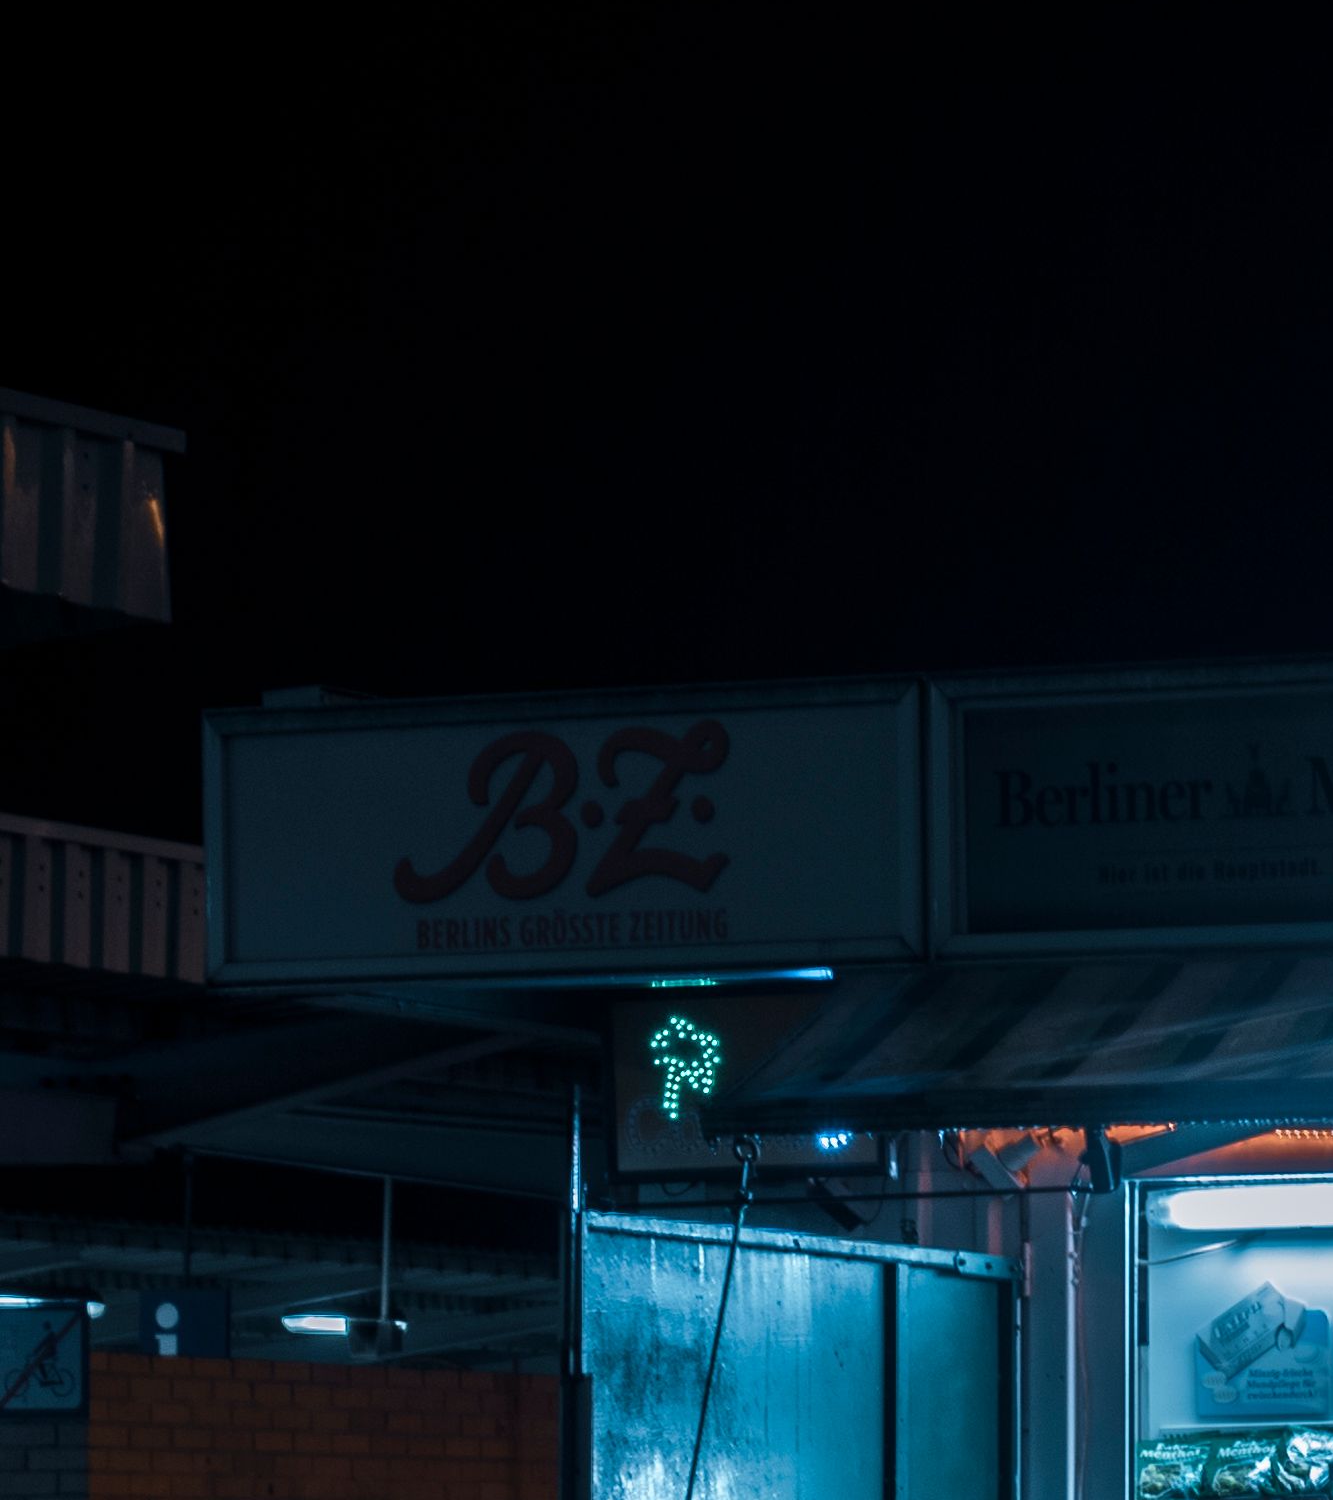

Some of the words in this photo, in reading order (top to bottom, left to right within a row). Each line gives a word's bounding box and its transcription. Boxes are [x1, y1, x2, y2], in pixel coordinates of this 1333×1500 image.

[991, 760, 1213, 829] Berliner
[1144, 861, 1171, 883] ist
[1177, 860, 1205, 881] die
[416, 914, 511, 951] BERLINS
[519, 905, 621, 948] GRÖSSTE
[629, 907, 730, 944] ZEITUNG
